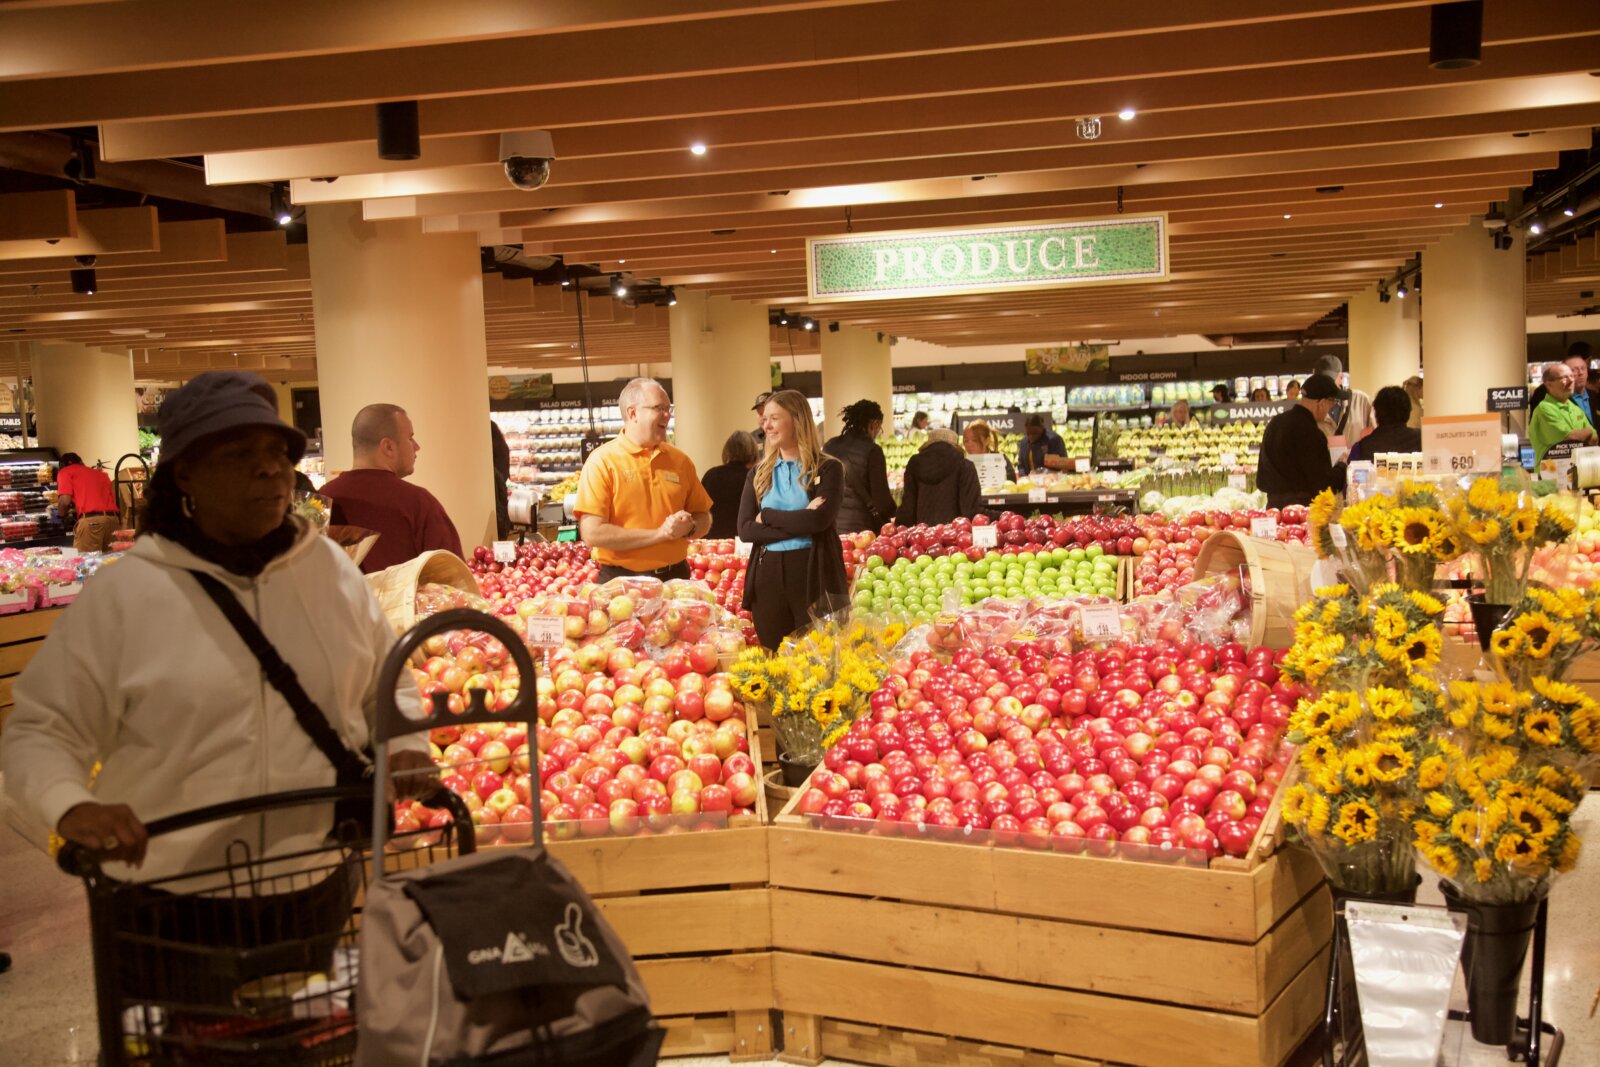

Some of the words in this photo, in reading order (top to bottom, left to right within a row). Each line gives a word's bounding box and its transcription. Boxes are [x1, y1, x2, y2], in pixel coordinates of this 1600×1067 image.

[873, 236, 1099, 281] PRODUCE
[1120, 373, 1148, 381] INDOOR
[1149, 372, 1176, 380] GROWN
[1491, 389, 1524, 400] SCALE
[540, 401, 560, 409] SALAD
[560, 400, 581, 408] BOWLS
[1230, 406, 1284, 419] BANANAS
[963, 418, 1014, 430] BANAS
[1569, 442, 1584, 450] YOUR
